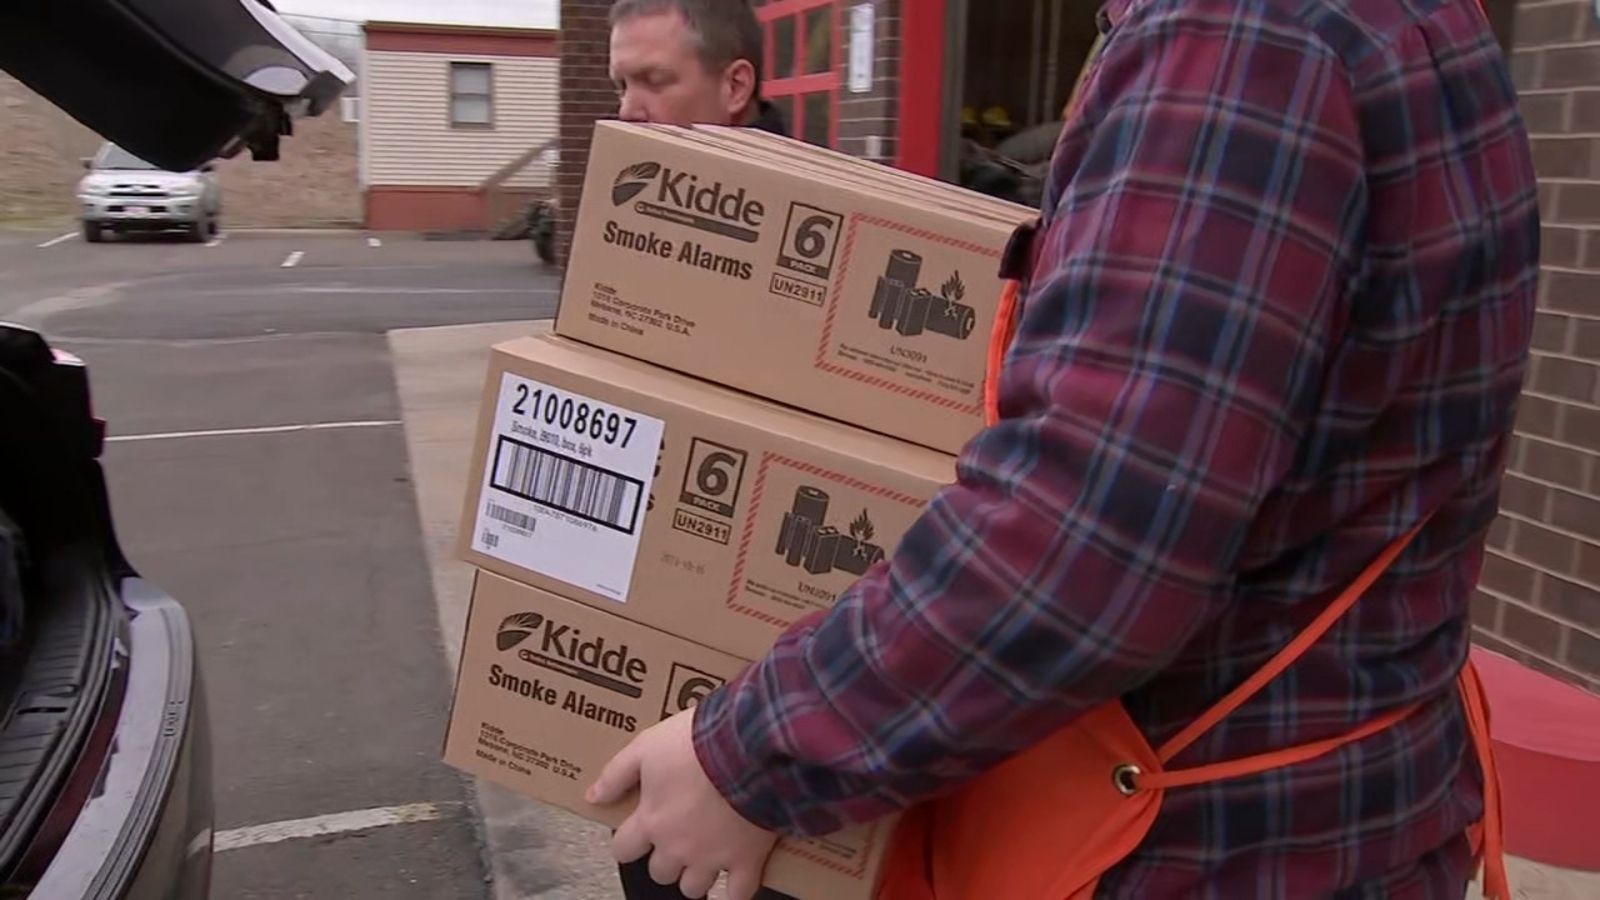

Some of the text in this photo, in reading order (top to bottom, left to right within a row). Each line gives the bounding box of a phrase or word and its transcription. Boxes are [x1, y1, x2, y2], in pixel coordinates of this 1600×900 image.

[658, 168, 764, 226] Kidde
[603, 220, 753, 280] Smoke Alarms
[795, 215, 834, 258] 6
[789, 260, 818, 274] PACK
[775, 279, 823, 301] UN2911
[512, 383, 637, 448] 21008697
[697, 452, 737, 496] 6
[693, 496, 721, 511] PACK
[677, 514, 727, 539] UN2911
[541, 620, 647, 683] Kidde
[488, 664, 637, 732] Smoke Alarms
